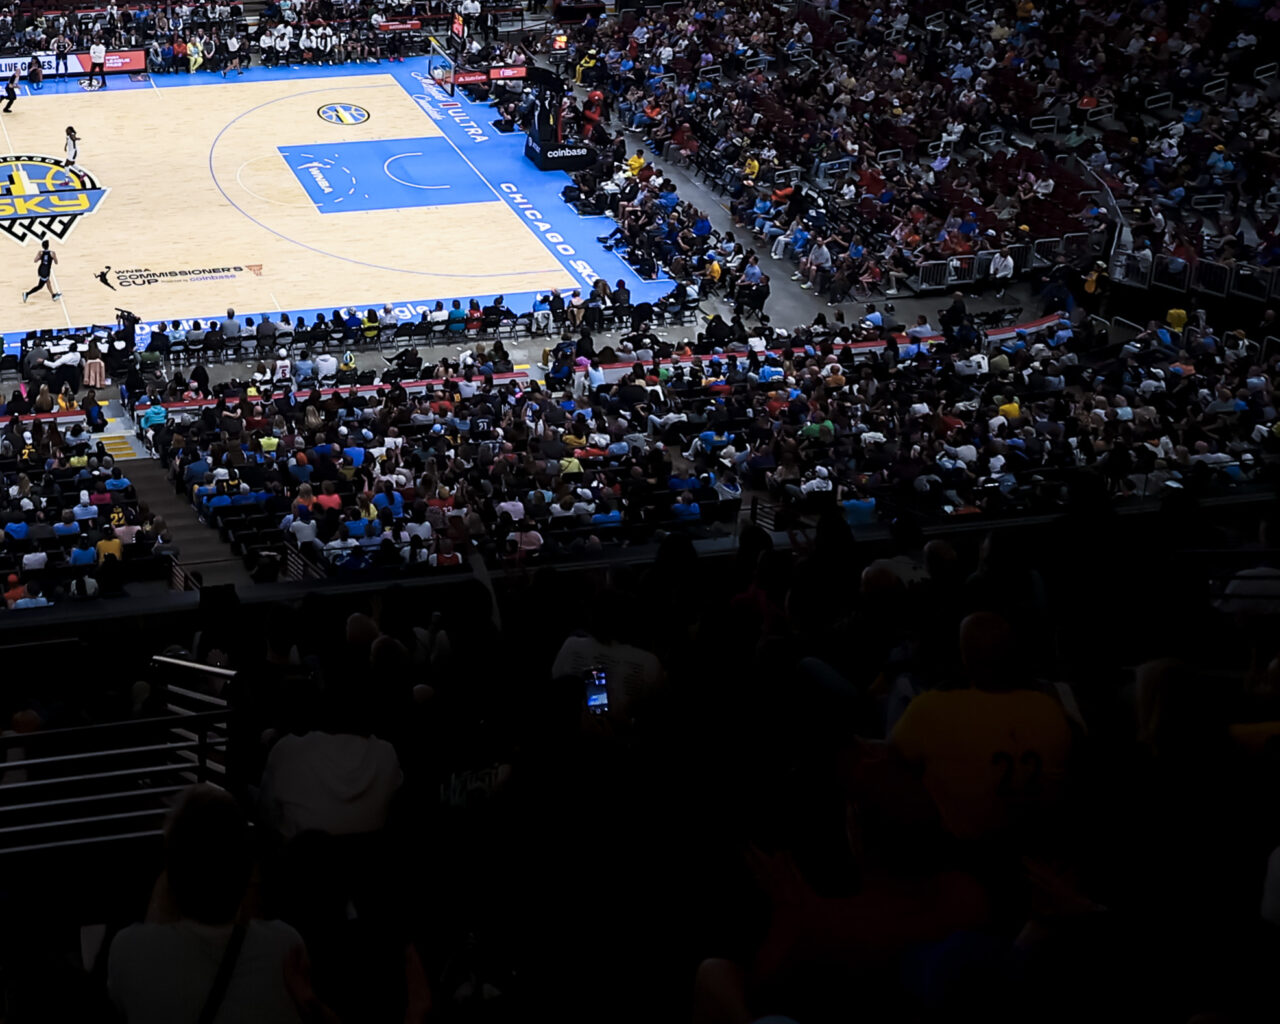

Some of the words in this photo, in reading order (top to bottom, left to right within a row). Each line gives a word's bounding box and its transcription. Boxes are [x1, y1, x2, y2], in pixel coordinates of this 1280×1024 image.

[0, 62, 19, 73] LIVE
[448, 108, 489, 143] ULTRA
[547, 148, 587, 158] coinbase
[308, 167, 334, 195] WNBA
[500, 182, 576, 256] CHICAGO
[117, 266, 243, 281] COMMISSIONER'S
[120, 278, 159, 287] CUP
[189, 273, 237, 282] coinbase
